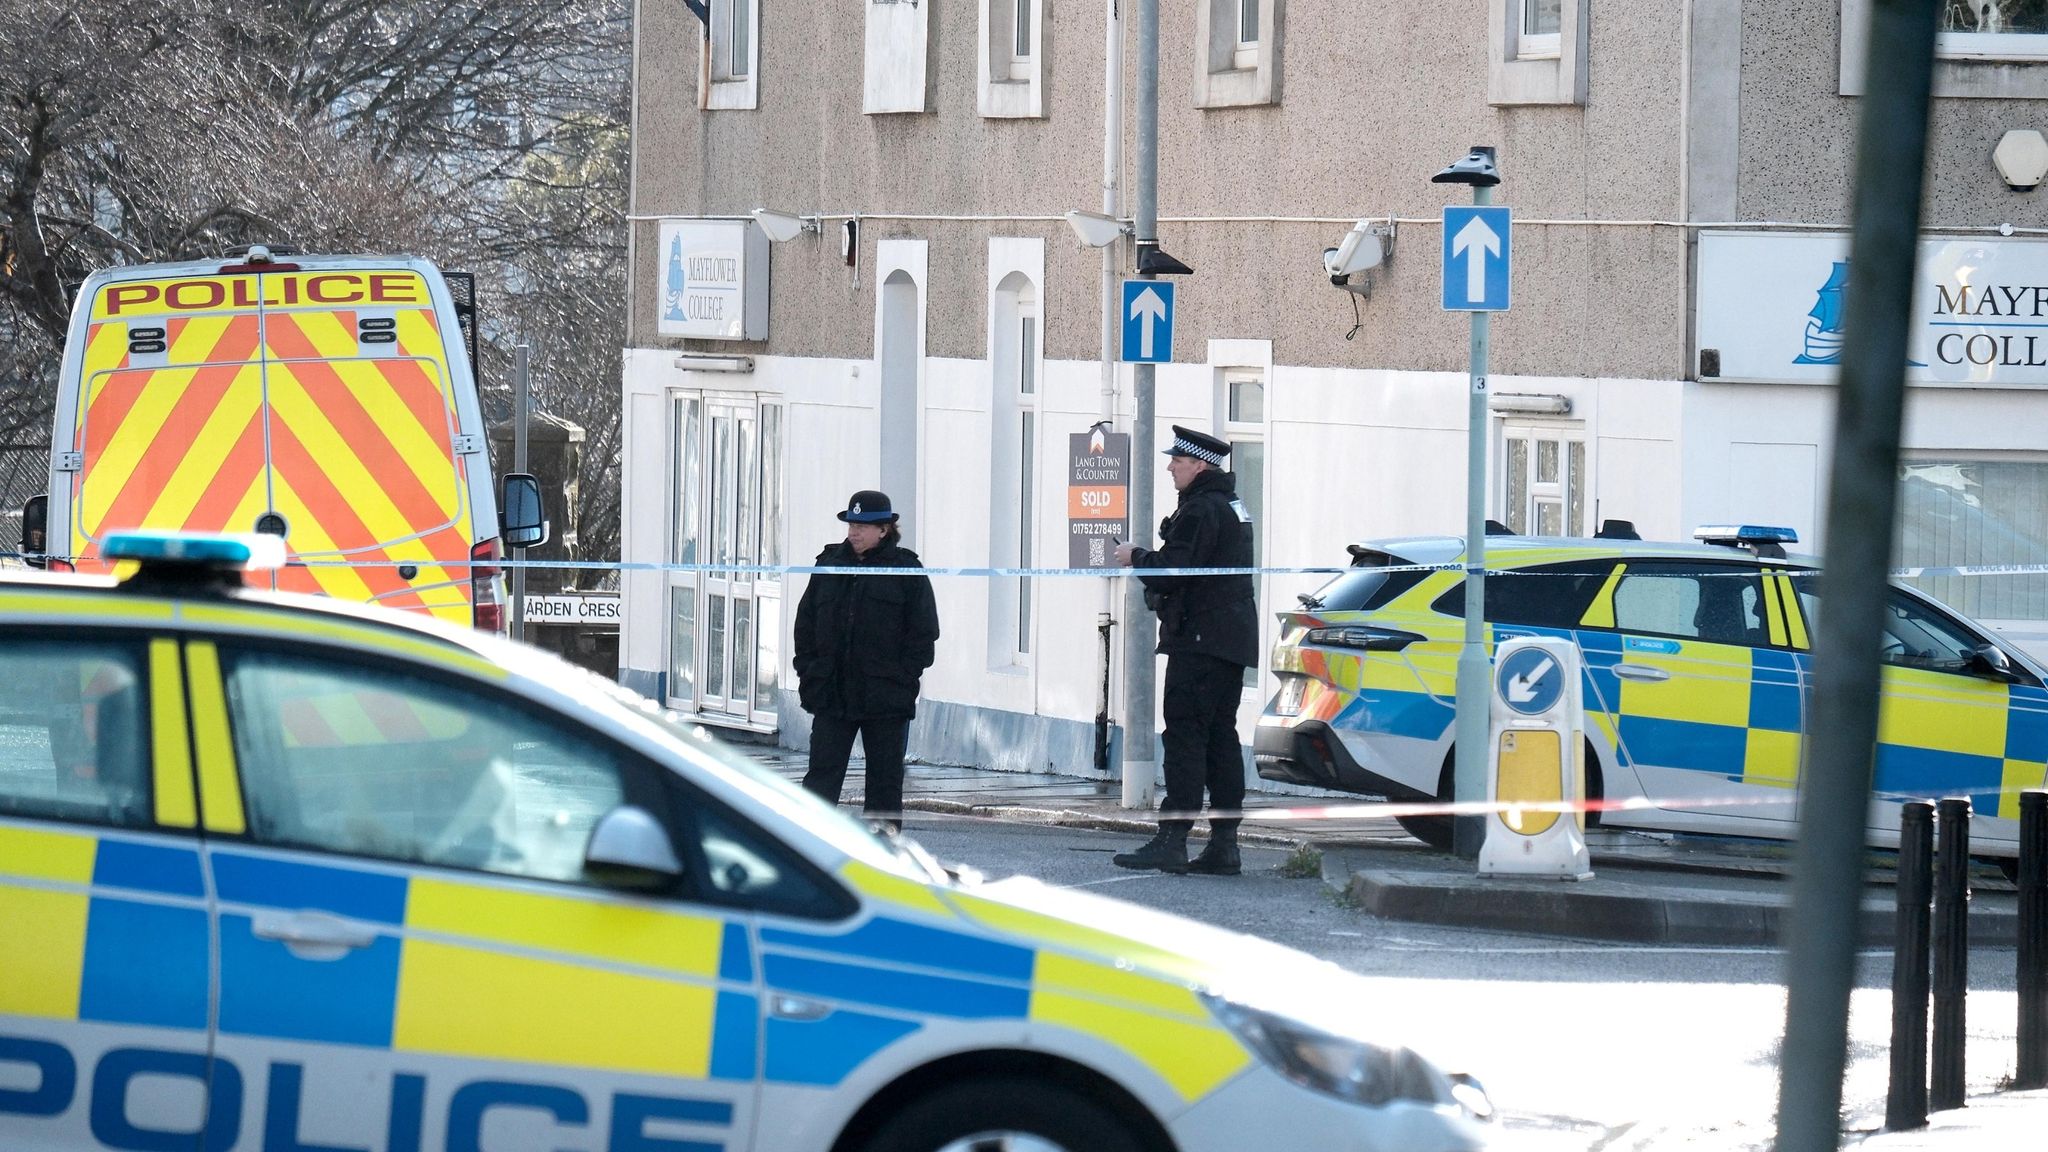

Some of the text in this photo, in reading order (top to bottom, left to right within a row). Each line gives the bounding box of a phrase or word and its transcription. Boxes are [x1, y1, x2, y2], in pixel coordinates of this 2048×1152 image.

[688, 257, 737, 282] MAYFLOWER
[106, 275, 417, 315] POLICE
[688, 295, 724, 320] COLLEGE
[1936, 333, 2048, 366] COLL
[1477, 377, 1485, 389] 3
[1075, 456, 1120, 467] LANG TOWN
[1081, 491, 1110, 507] SOLD
[1072, 523, 1122, 534] 01752 278499
[525, 602, 572, 617] ARDEN
[0, 1035, 734, 1152] POLICE
